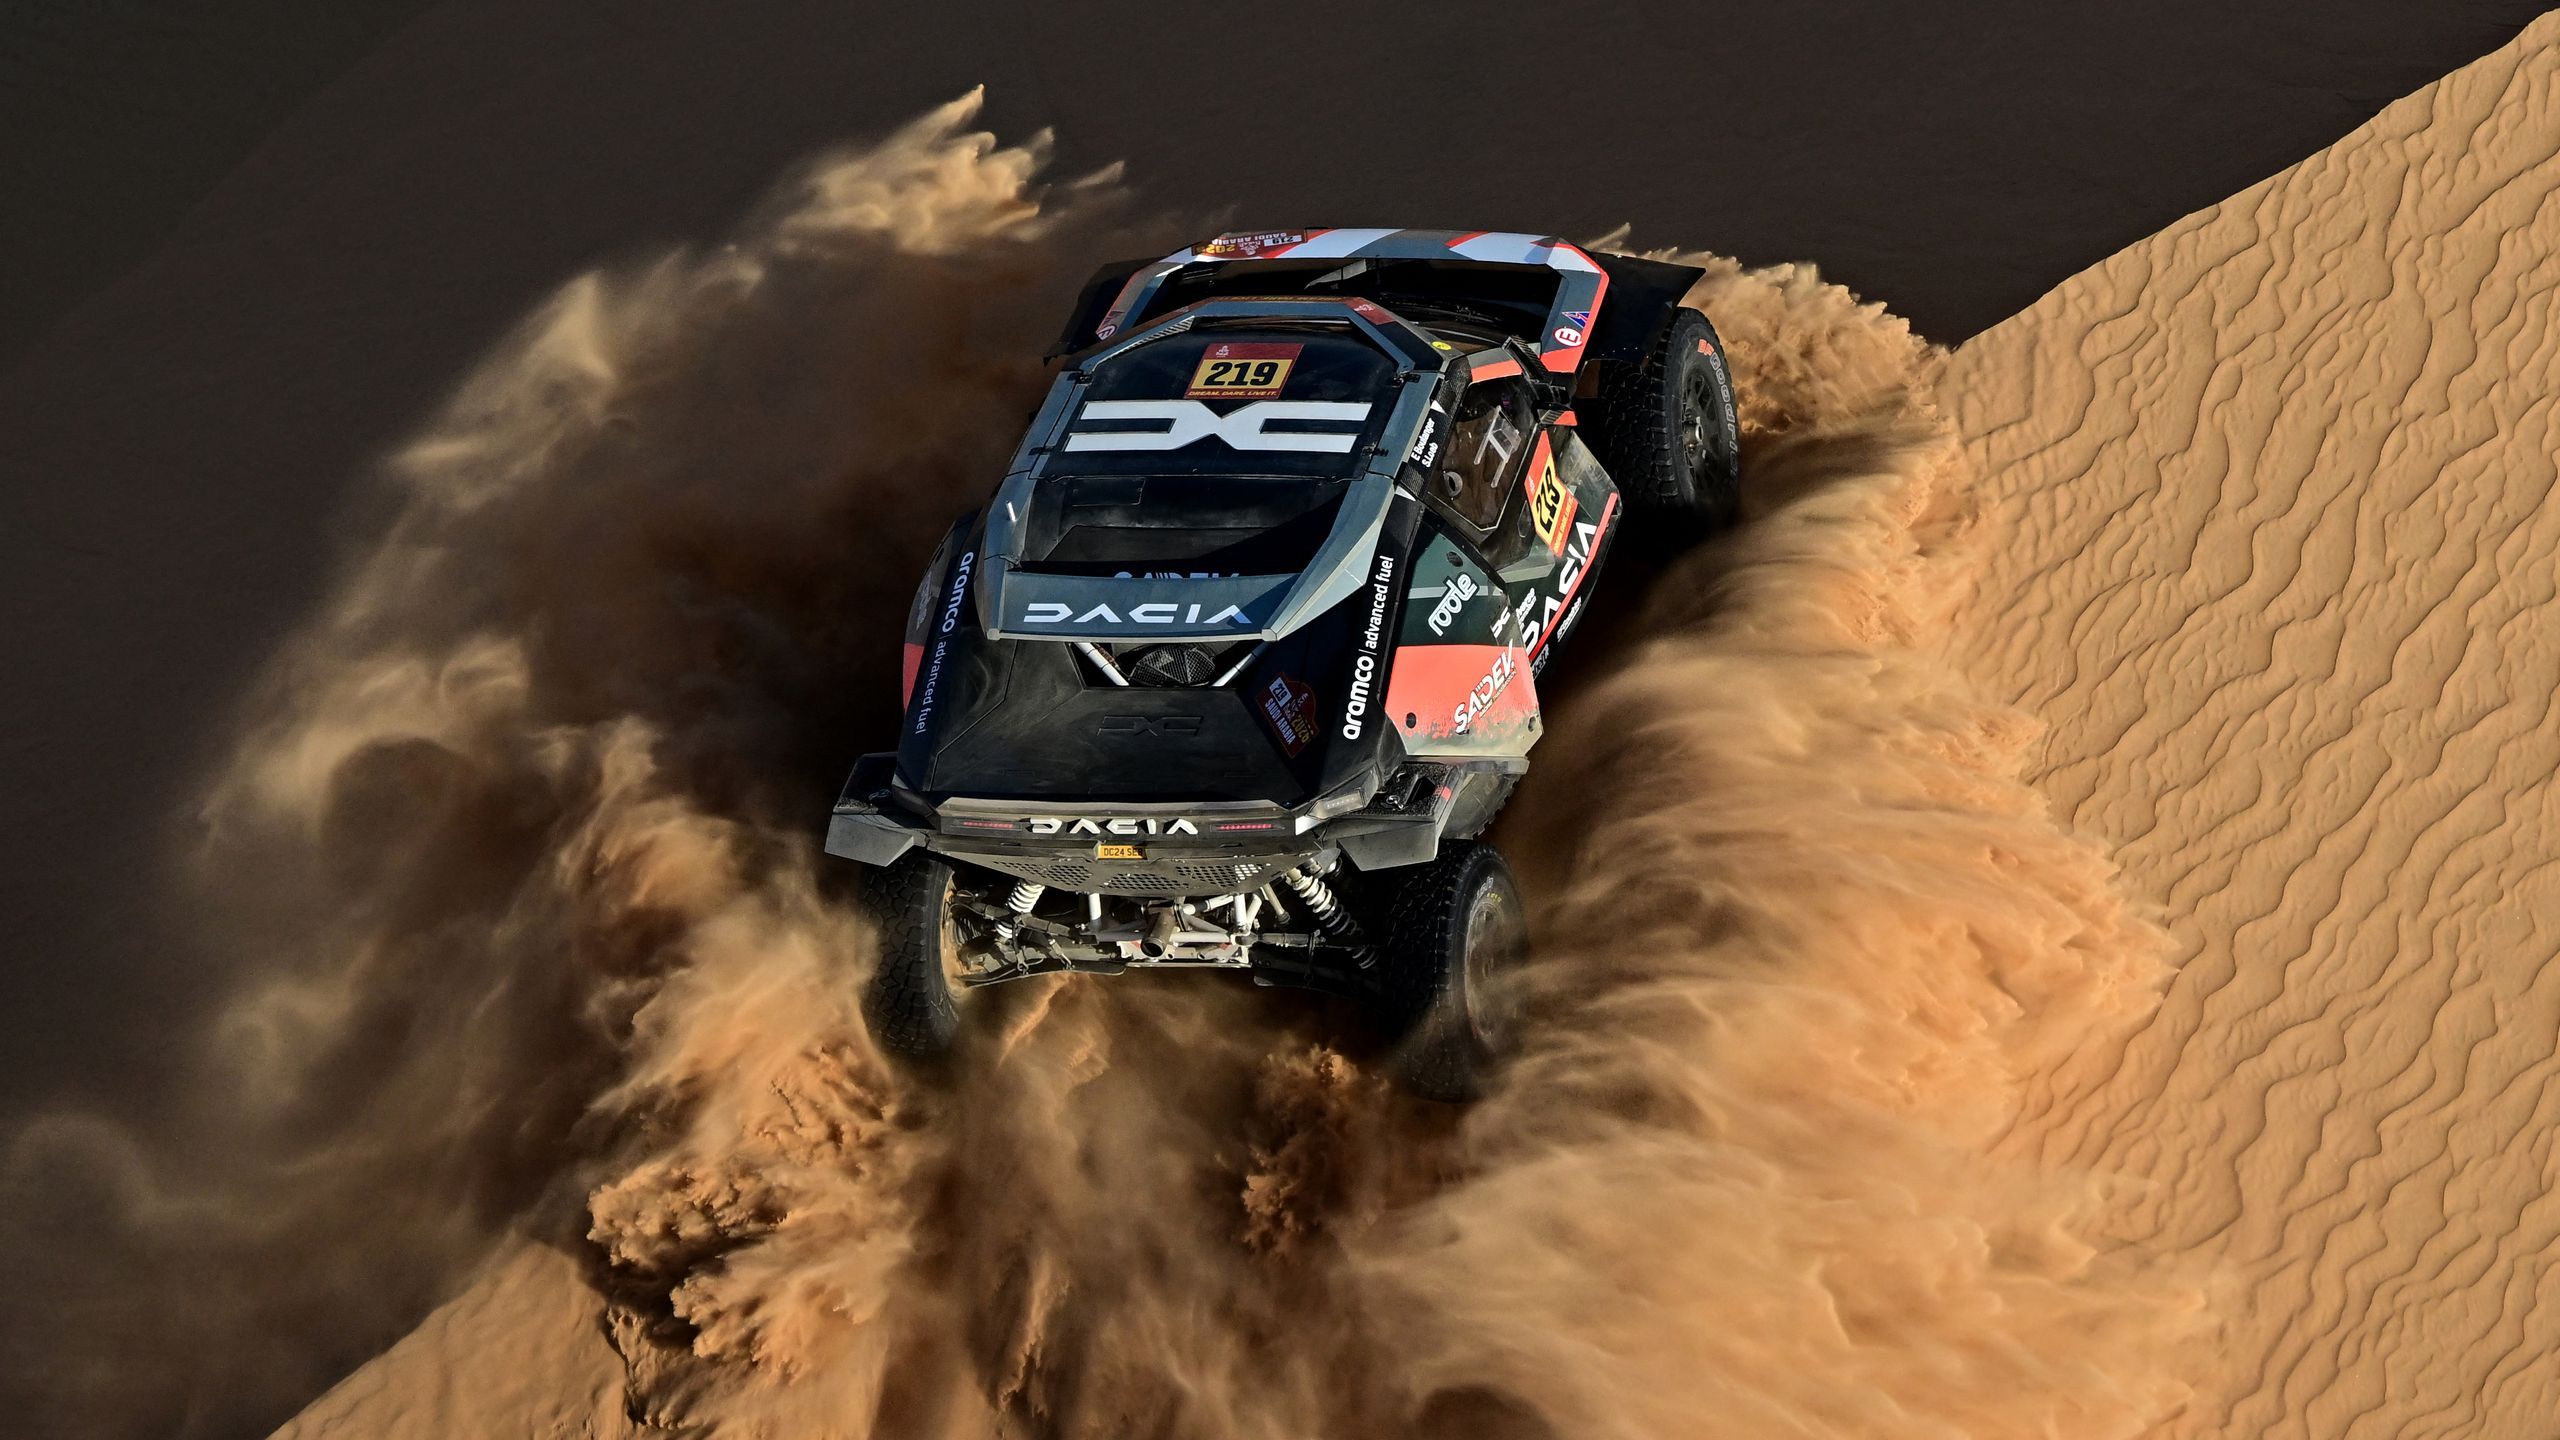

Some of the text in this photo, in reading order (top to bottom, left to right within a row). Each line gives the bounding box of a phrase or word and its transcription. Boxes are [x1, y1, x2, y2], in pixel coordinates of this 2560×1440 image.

[1212, 235, 1252, 245] ARABIA
[1254, 232, 1286, 241] SAUDI
[1203, 362, 1279, 386] 219
[1412, 417, 1435, 455] Boulanger
[1536, 466, 1561, 534] 219
[941, 551, 974, 633] aramco
[1427, 572, 1478, 637] roole
[1023, 603, 1252, 624] DACIA
[1342, 555, 1394, 740] aramco advanced fuel
[922, 641, 947, 707] advanced
[1454, 638, 1515, 734] SADEV
[1273, 683, 1288, 702] 219
[914, 707, 934, 735] fuel
[1265, 697, 1297, 745] SAUDI ARABIA
[1030, 818, 1198, 835] DACIA
[1104, 847, 1143, 857] DC24 SEB
